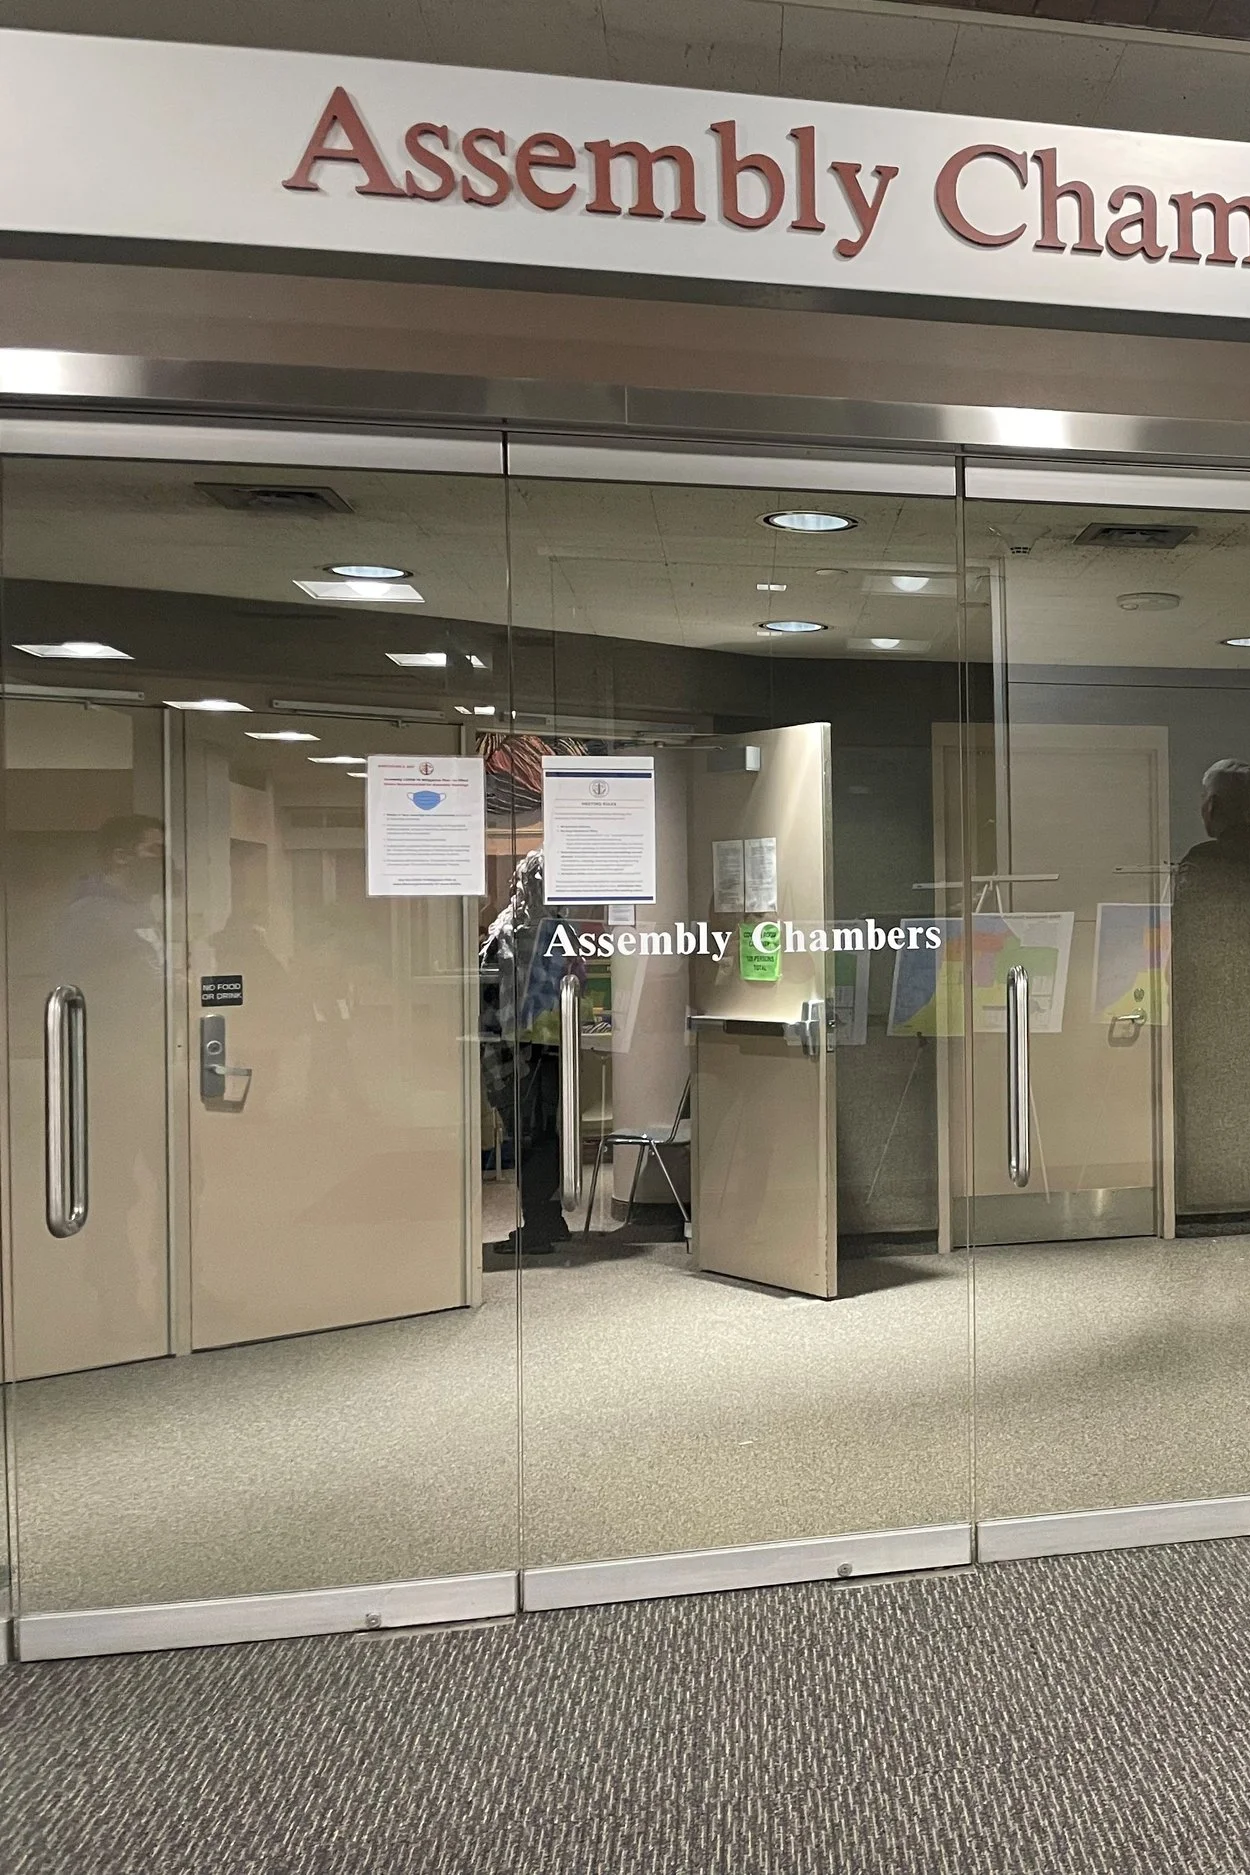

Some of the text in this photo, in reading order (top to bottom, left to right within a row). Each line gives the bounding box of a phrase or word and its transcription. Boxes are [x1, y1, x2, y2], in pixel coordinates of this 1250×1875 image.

[283, 87, 899, 258] Assembly
[543, 918, 942, 961] Assembly Chambers
[202, 992, 242, 1001] OR DRINK
[217, 983, 241, 991] FOOD
